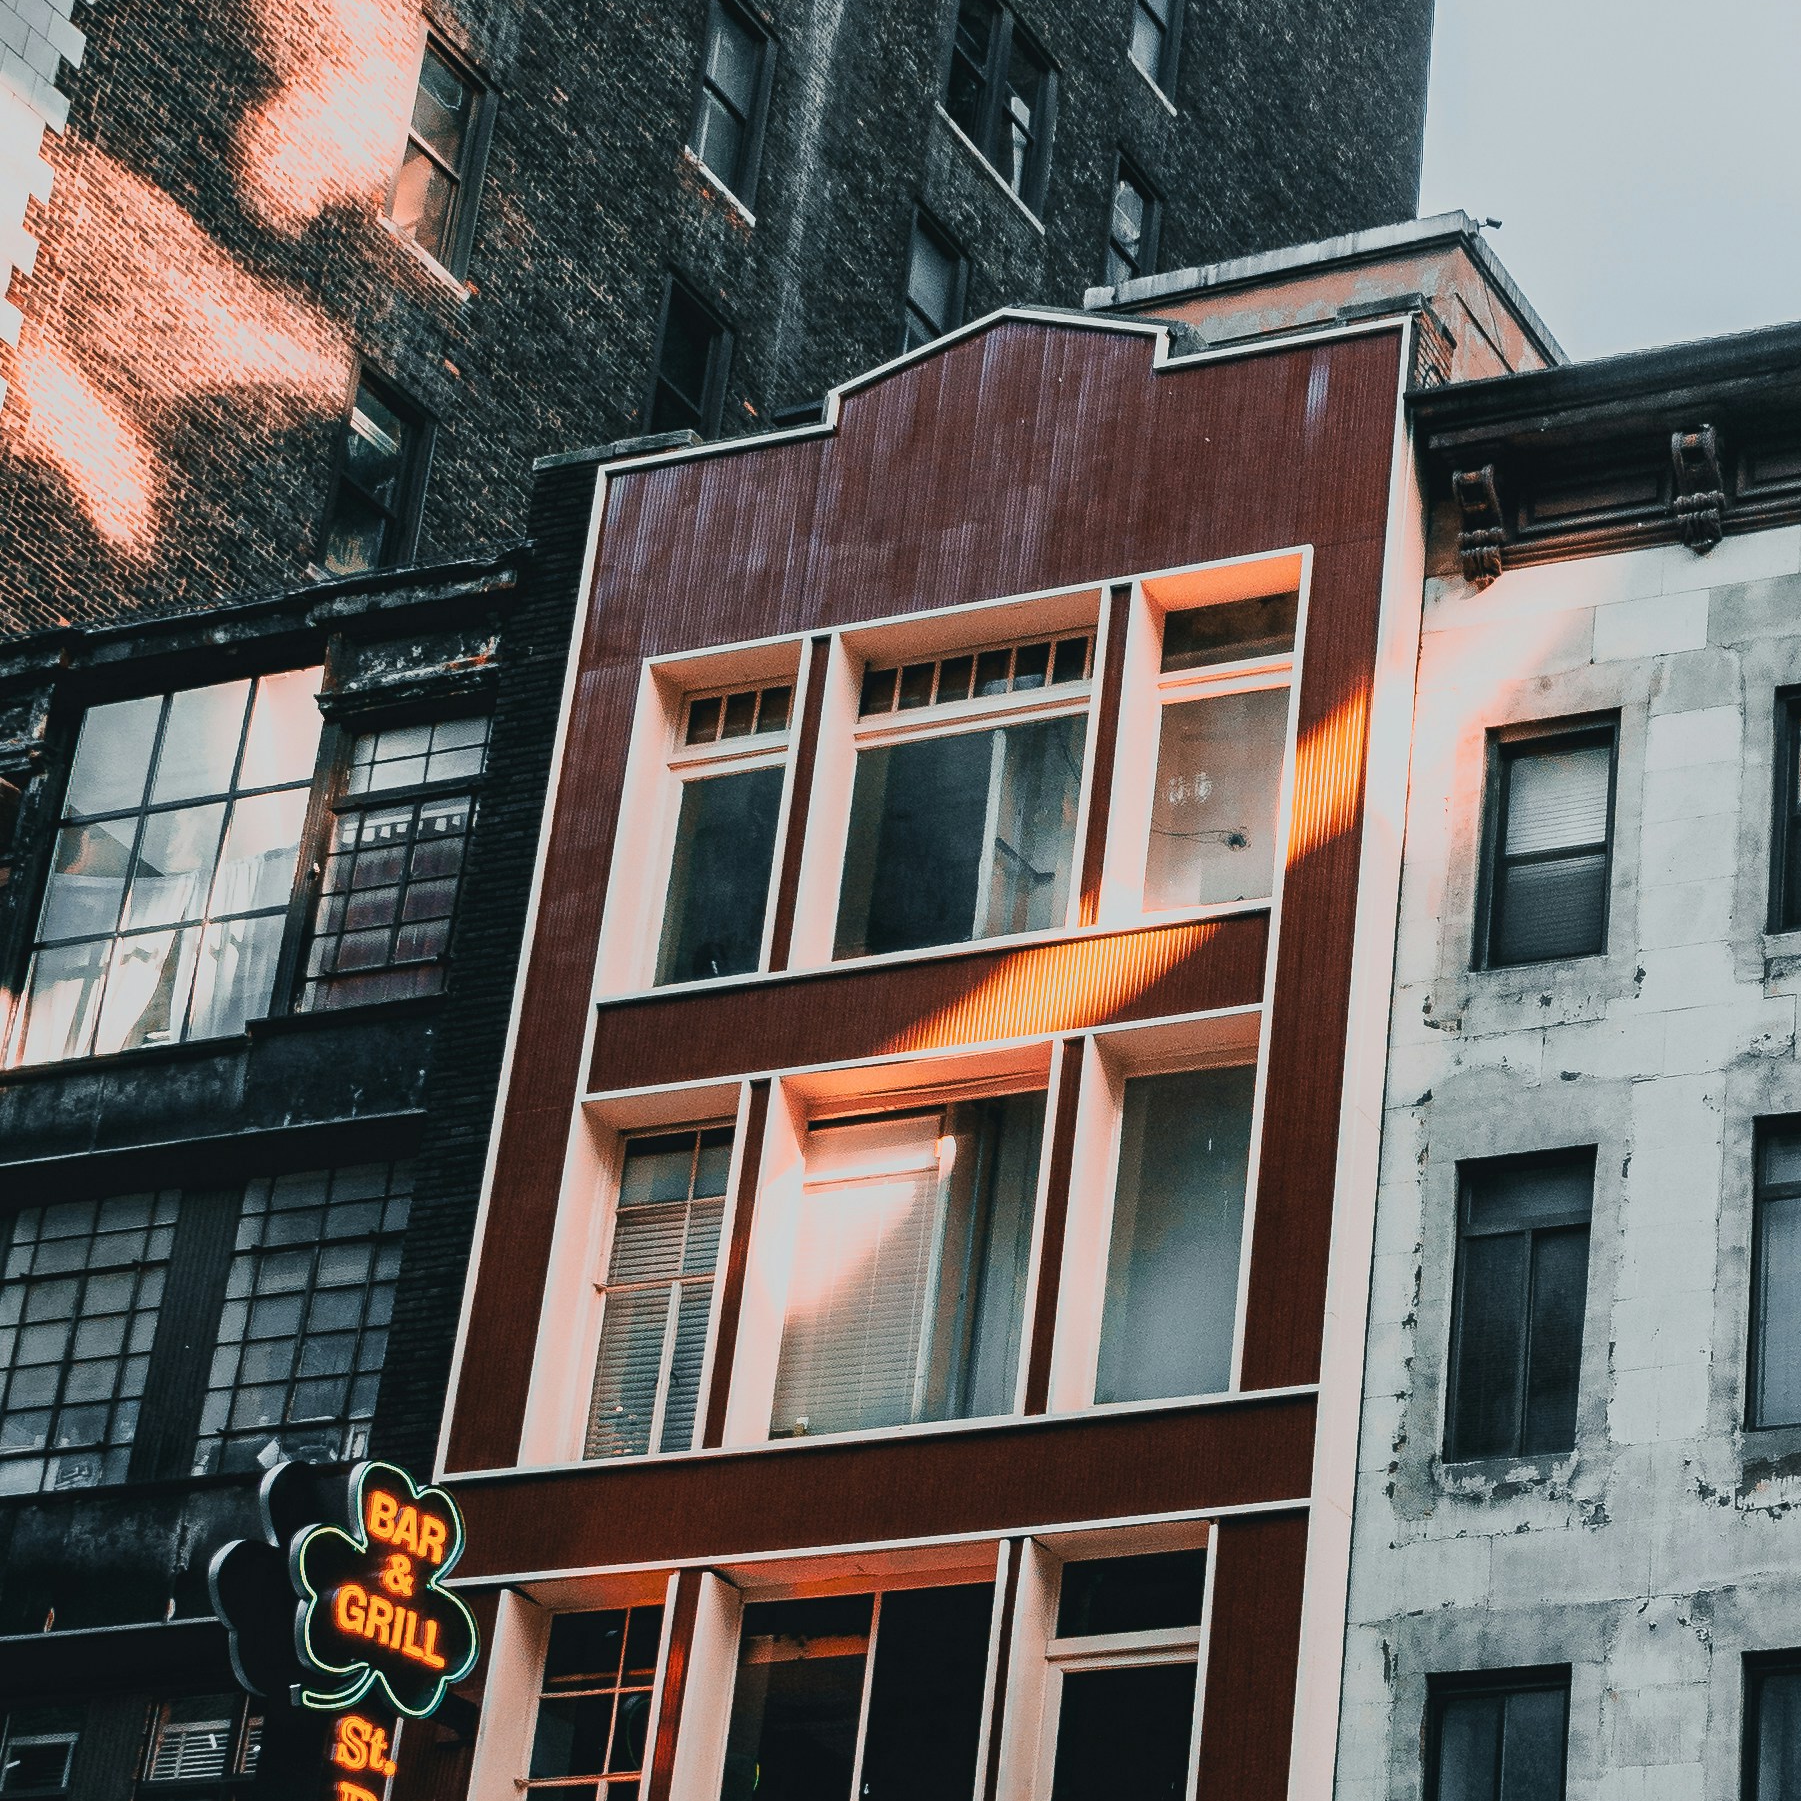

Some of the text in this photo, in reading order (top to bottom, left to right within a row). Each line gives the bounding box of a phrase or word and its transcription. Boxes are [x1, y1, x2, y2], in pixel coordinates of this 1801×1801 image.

[368, 1489, 448, 1566] BAR
[383, 1553, 415, 1597] &
[335, 1584, 446, 1670] GRILL
[336, 1715, 397, 1777] St.
